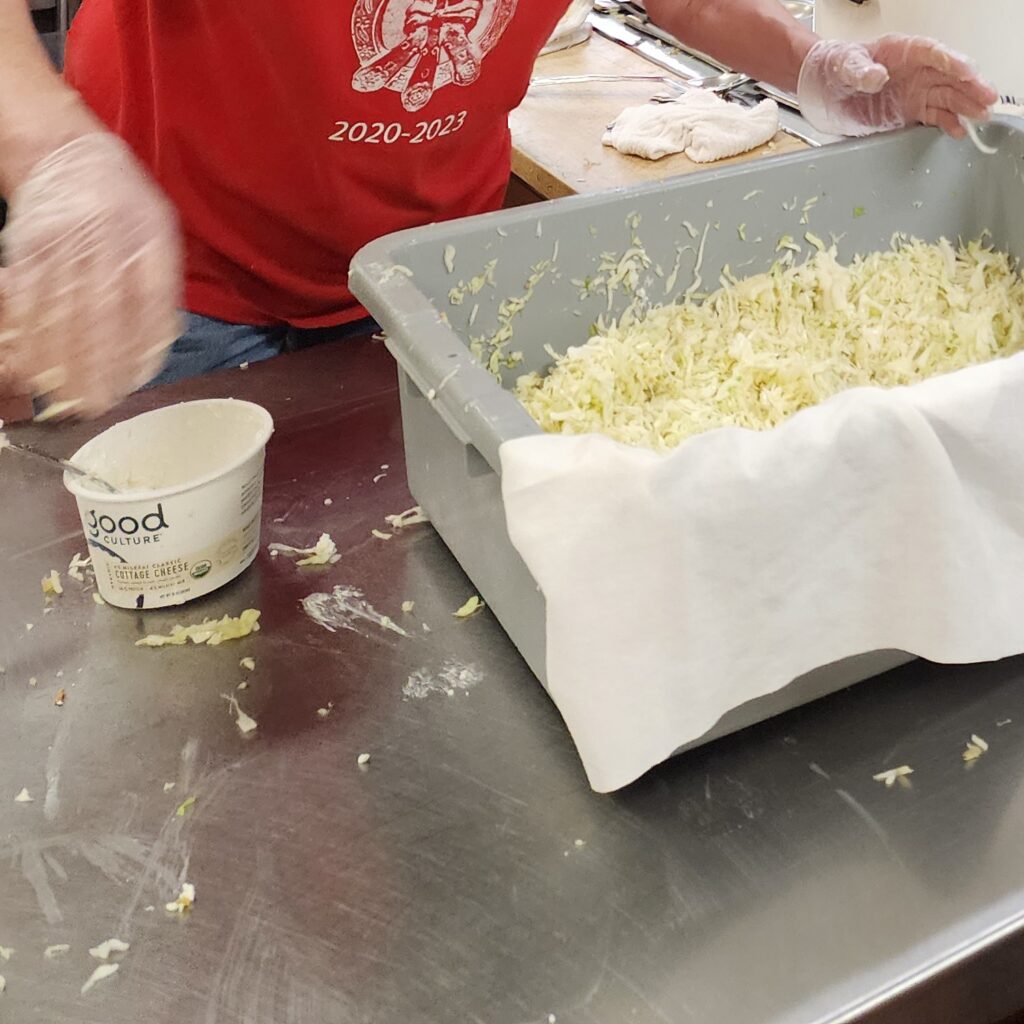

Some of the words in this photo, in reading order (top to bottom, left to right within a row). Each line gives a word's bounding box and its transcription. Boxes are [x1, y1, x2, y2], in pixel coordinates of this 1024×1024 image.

[328, 110, 467, 144] 2020-2023
[88, 503, 169, 536] good
[104, 534, 161, 546] CULTURE
[115, 570, 150, 580] COTTAGE
[154, 562, 189, 578] CHEESE
